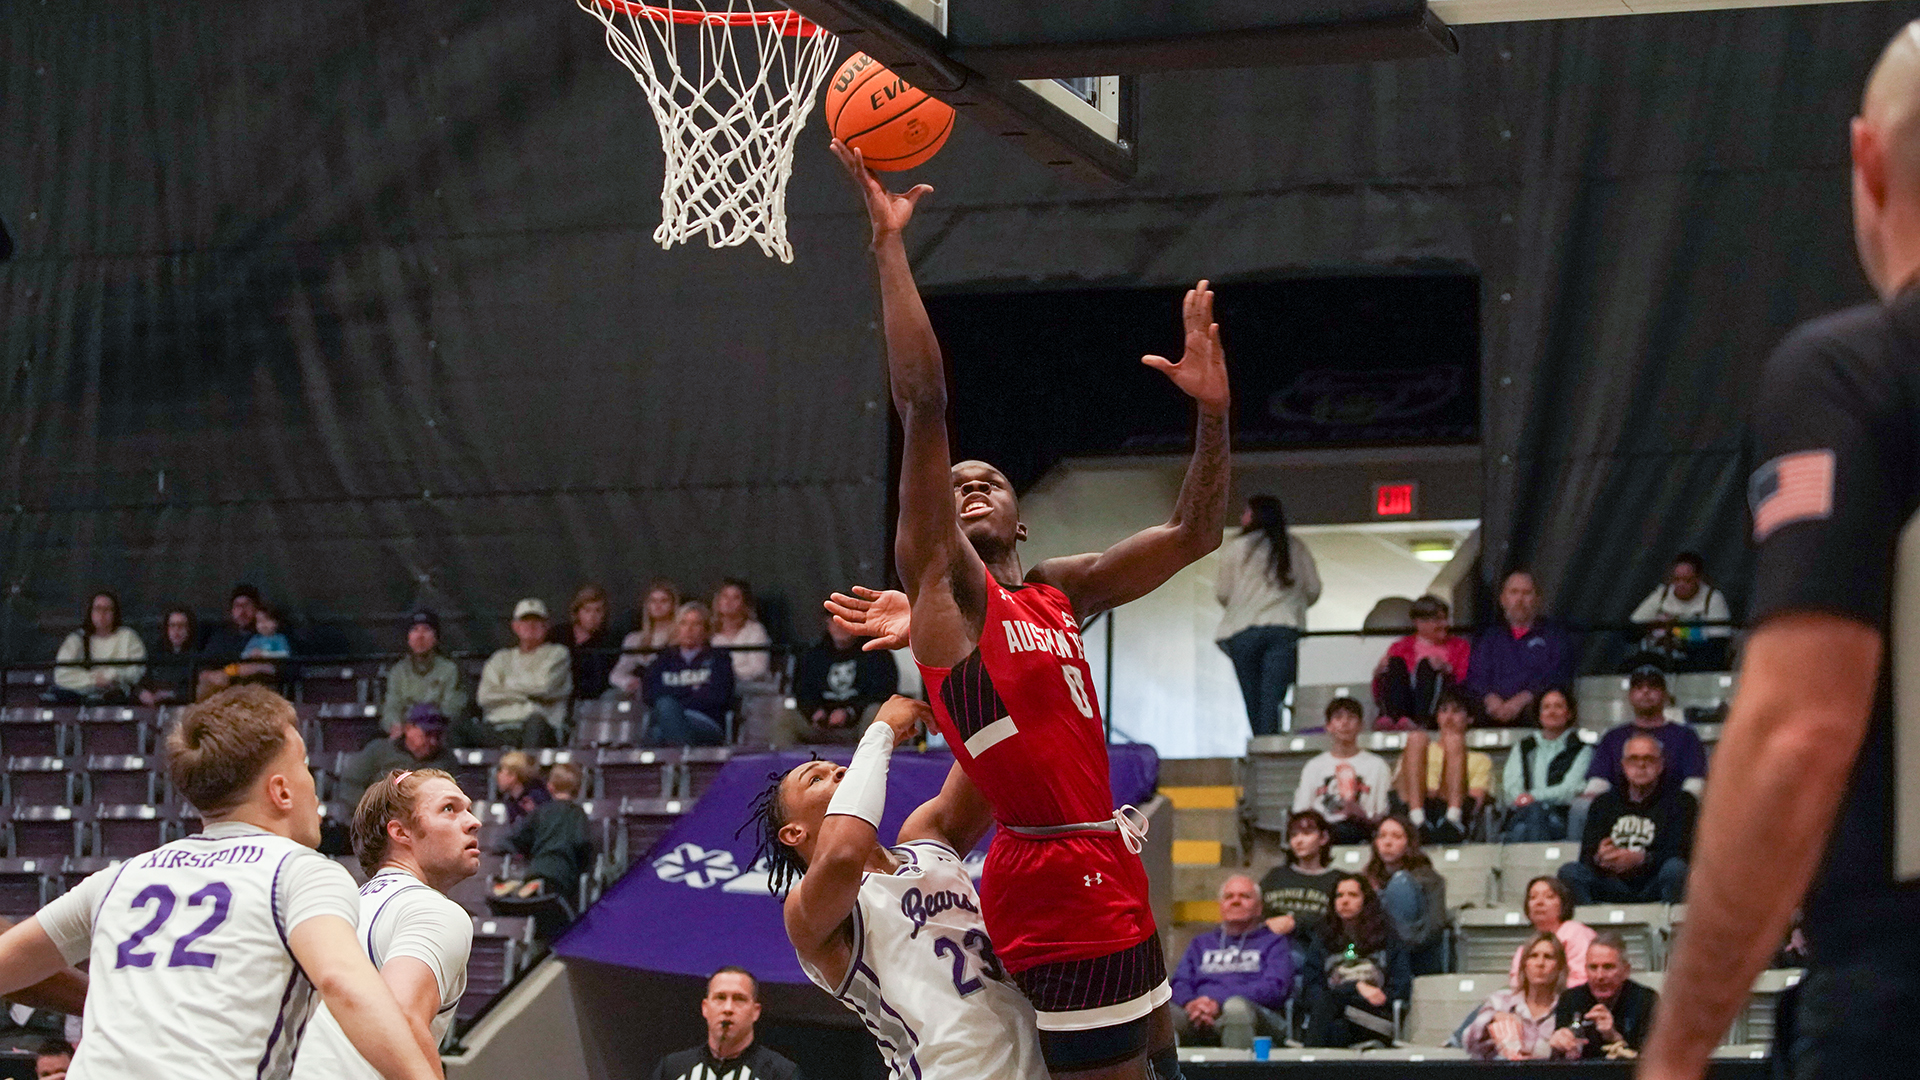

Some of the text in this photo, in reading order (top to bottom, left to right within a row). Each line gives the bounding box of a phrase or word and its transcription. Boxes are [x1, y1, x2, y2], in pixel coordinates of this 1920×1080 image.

[1061, 664, 1094, 719] 0
[114, 881, 234, 970] 22
[901, 887, 979, 939] Bears
[934, 928, 1006, 996] 23
